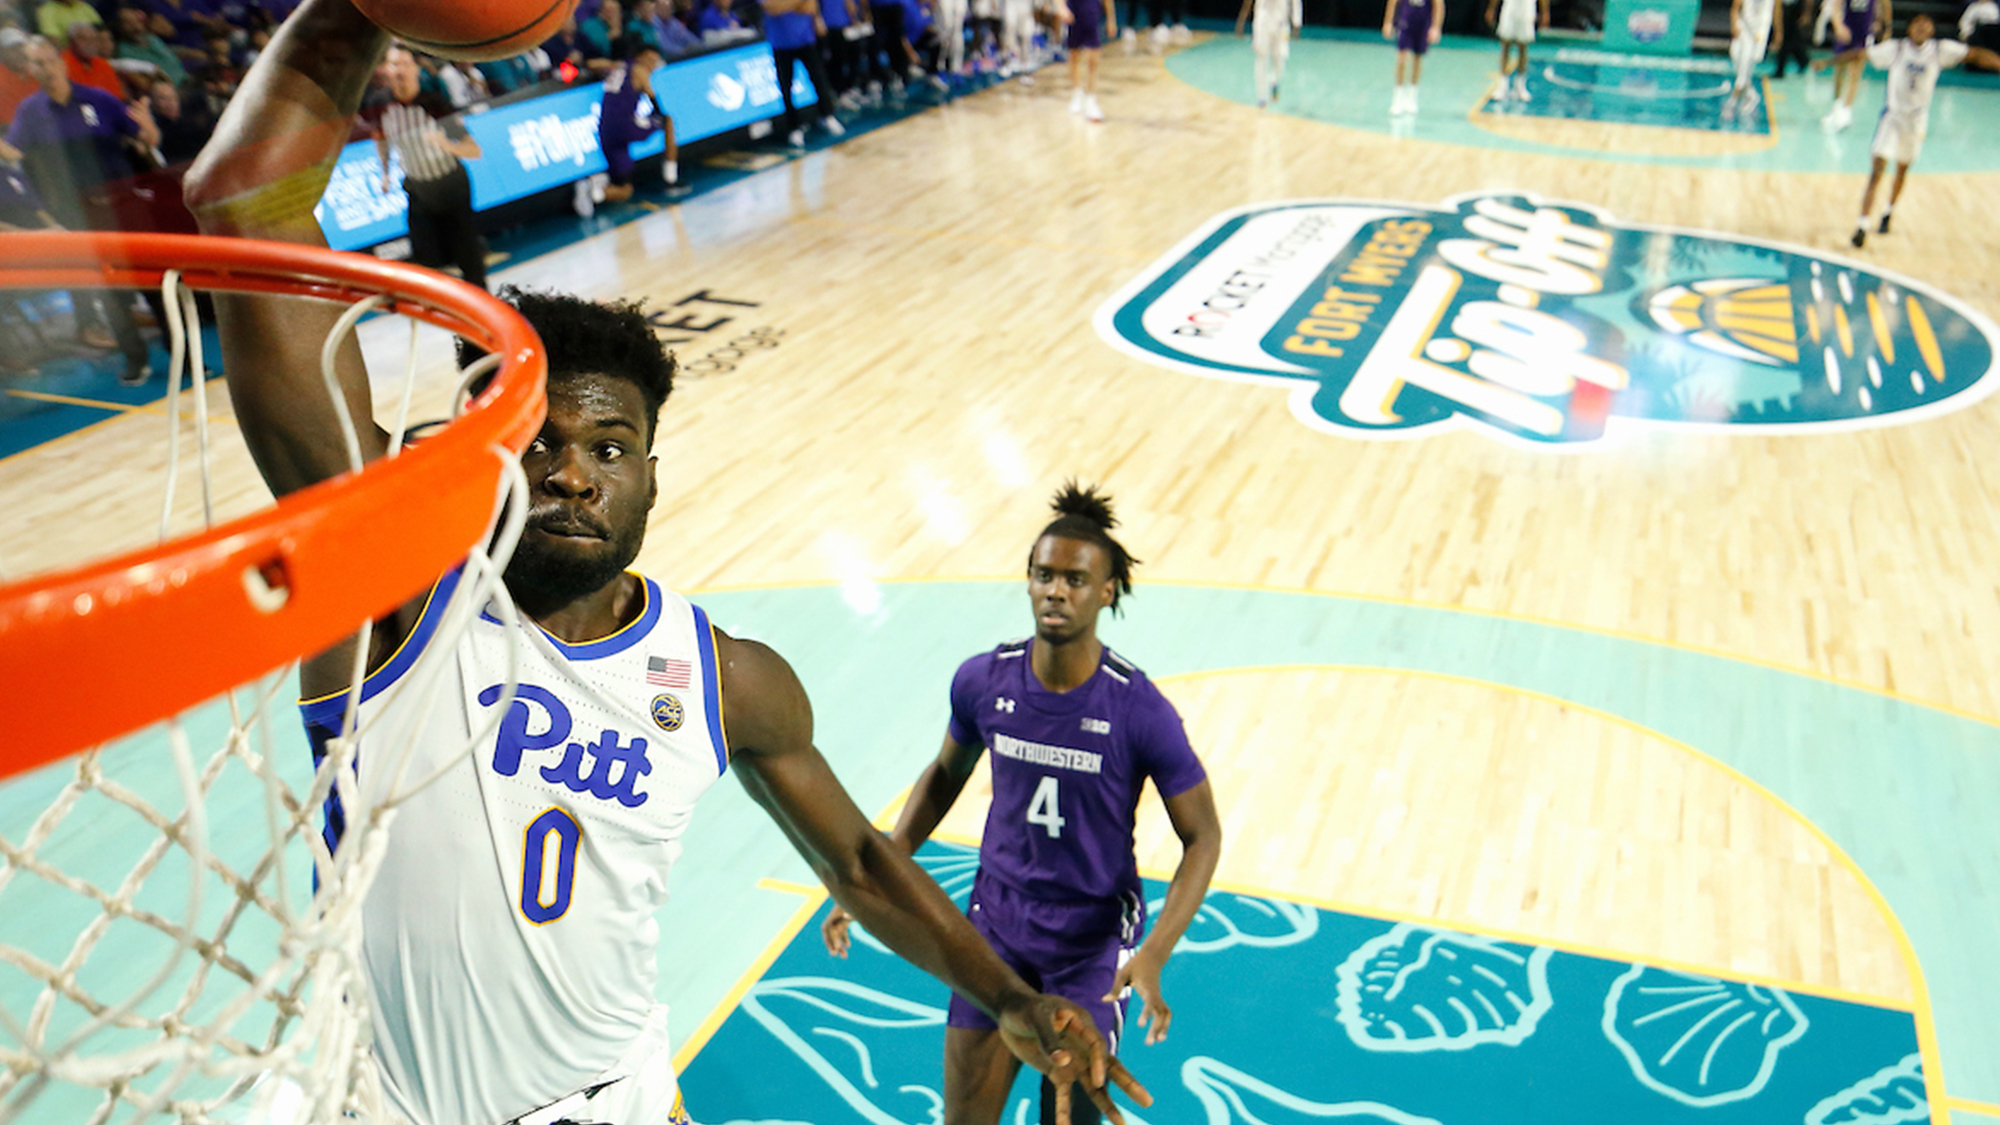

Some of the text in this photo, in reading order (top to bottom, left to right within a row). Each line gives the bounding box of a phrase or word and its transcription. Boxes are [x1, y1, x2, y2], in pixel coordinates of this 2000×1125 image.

[1171, 268, 1275, 339] ROCKET
[1283, 218, 1433, 358] FORT MYERS
[477, 683, 653, 808] Pitt
[993, 732, 1103, 774] NORTHWESTERN
[1026, 775, 1066, 839] 4
[518, 805, 584, 927] 0
